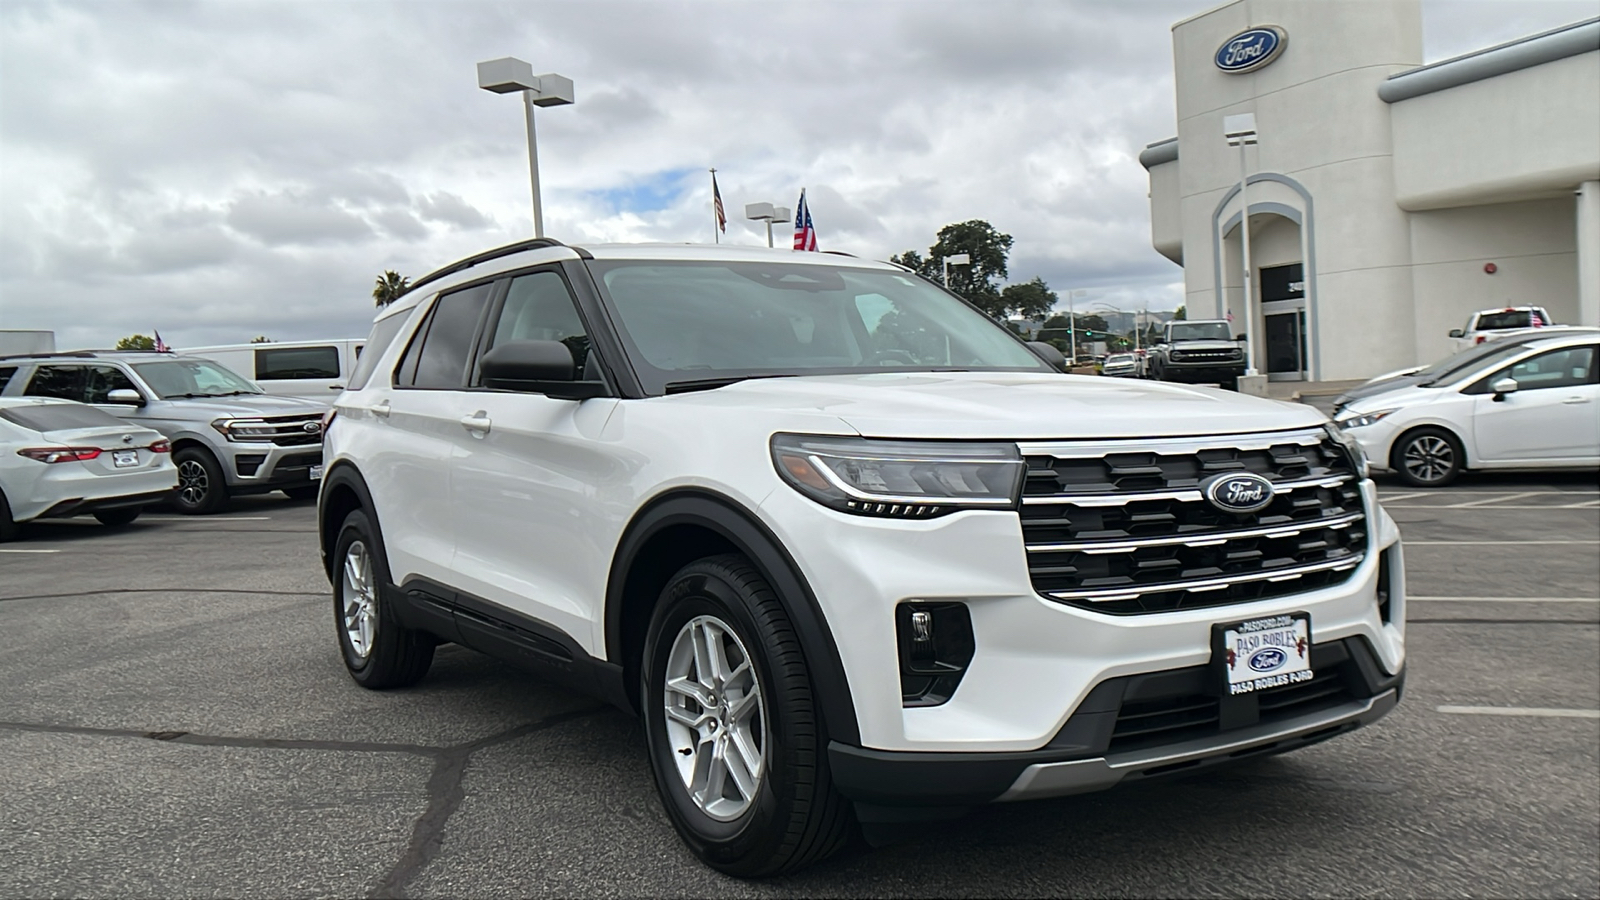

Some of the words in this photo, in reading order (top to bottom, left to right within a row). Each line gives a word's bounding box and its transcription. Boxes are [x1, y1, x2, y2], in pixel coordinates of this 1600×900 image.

[1225, 35, 1265, 65] Ford
[1227, 481, 1263, 503] Ford
[1236, 636, 1259, 657] PASO
[1262, 630, 1296, 647] ROBLES
[1255, 652, 1280, 668] Ford
[1230, 681, 1253, 694] PASO
[1254, 674, 1288, 690] ROBLES
[1289, 670, 1313, 683] FORD
